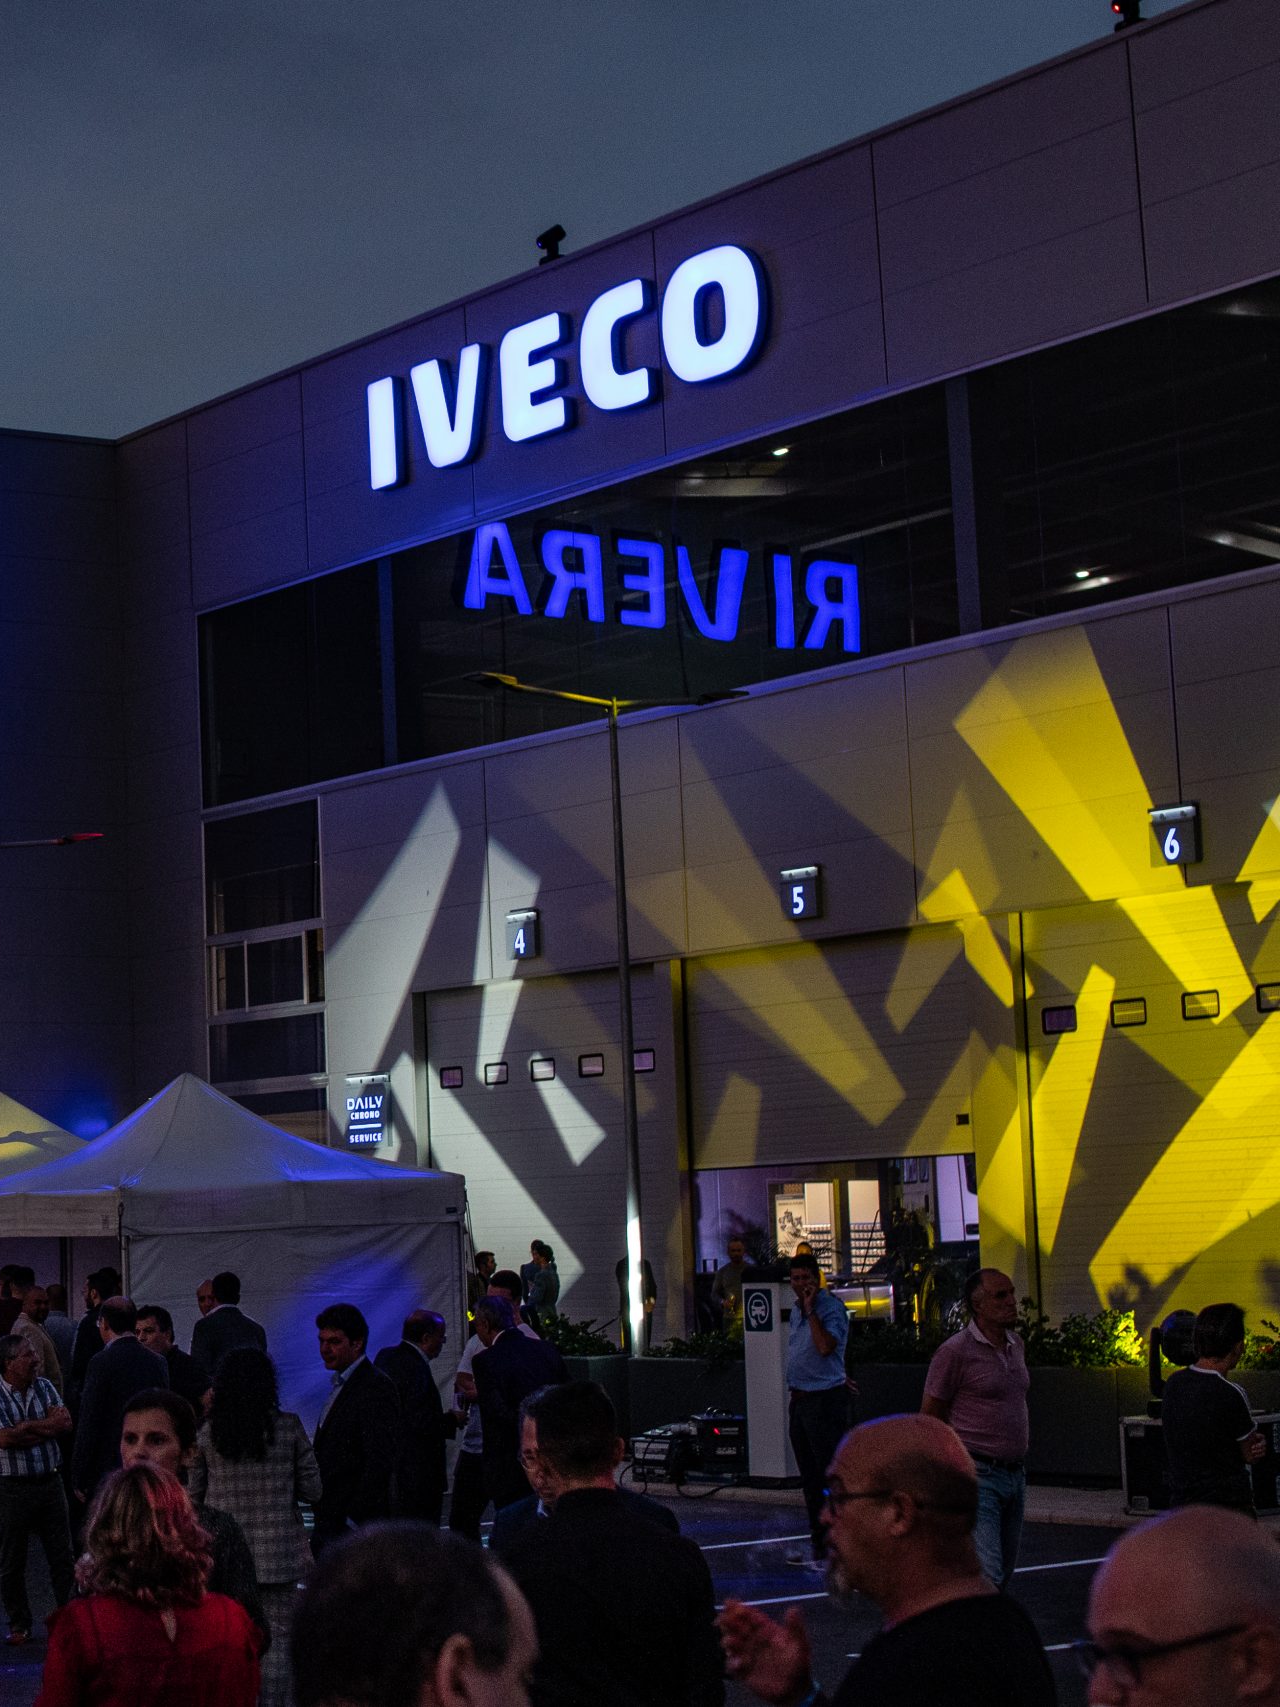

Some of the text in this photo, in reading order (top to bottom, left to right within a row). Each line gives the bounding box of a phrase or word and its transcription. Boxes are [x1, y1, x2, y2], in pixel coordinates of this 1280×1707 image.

[367, 245, 762, 491] IVECO
[1164, 828, 1180, 860] 6
[791, 886, 804, 914] 5
[514, 928, 526, 954] 4
[346, 1095, 384, 1110] DAILY
[350, 1110, 380, 1120] CHRONO
[349, 1132, 382, 1143] SERVICE
